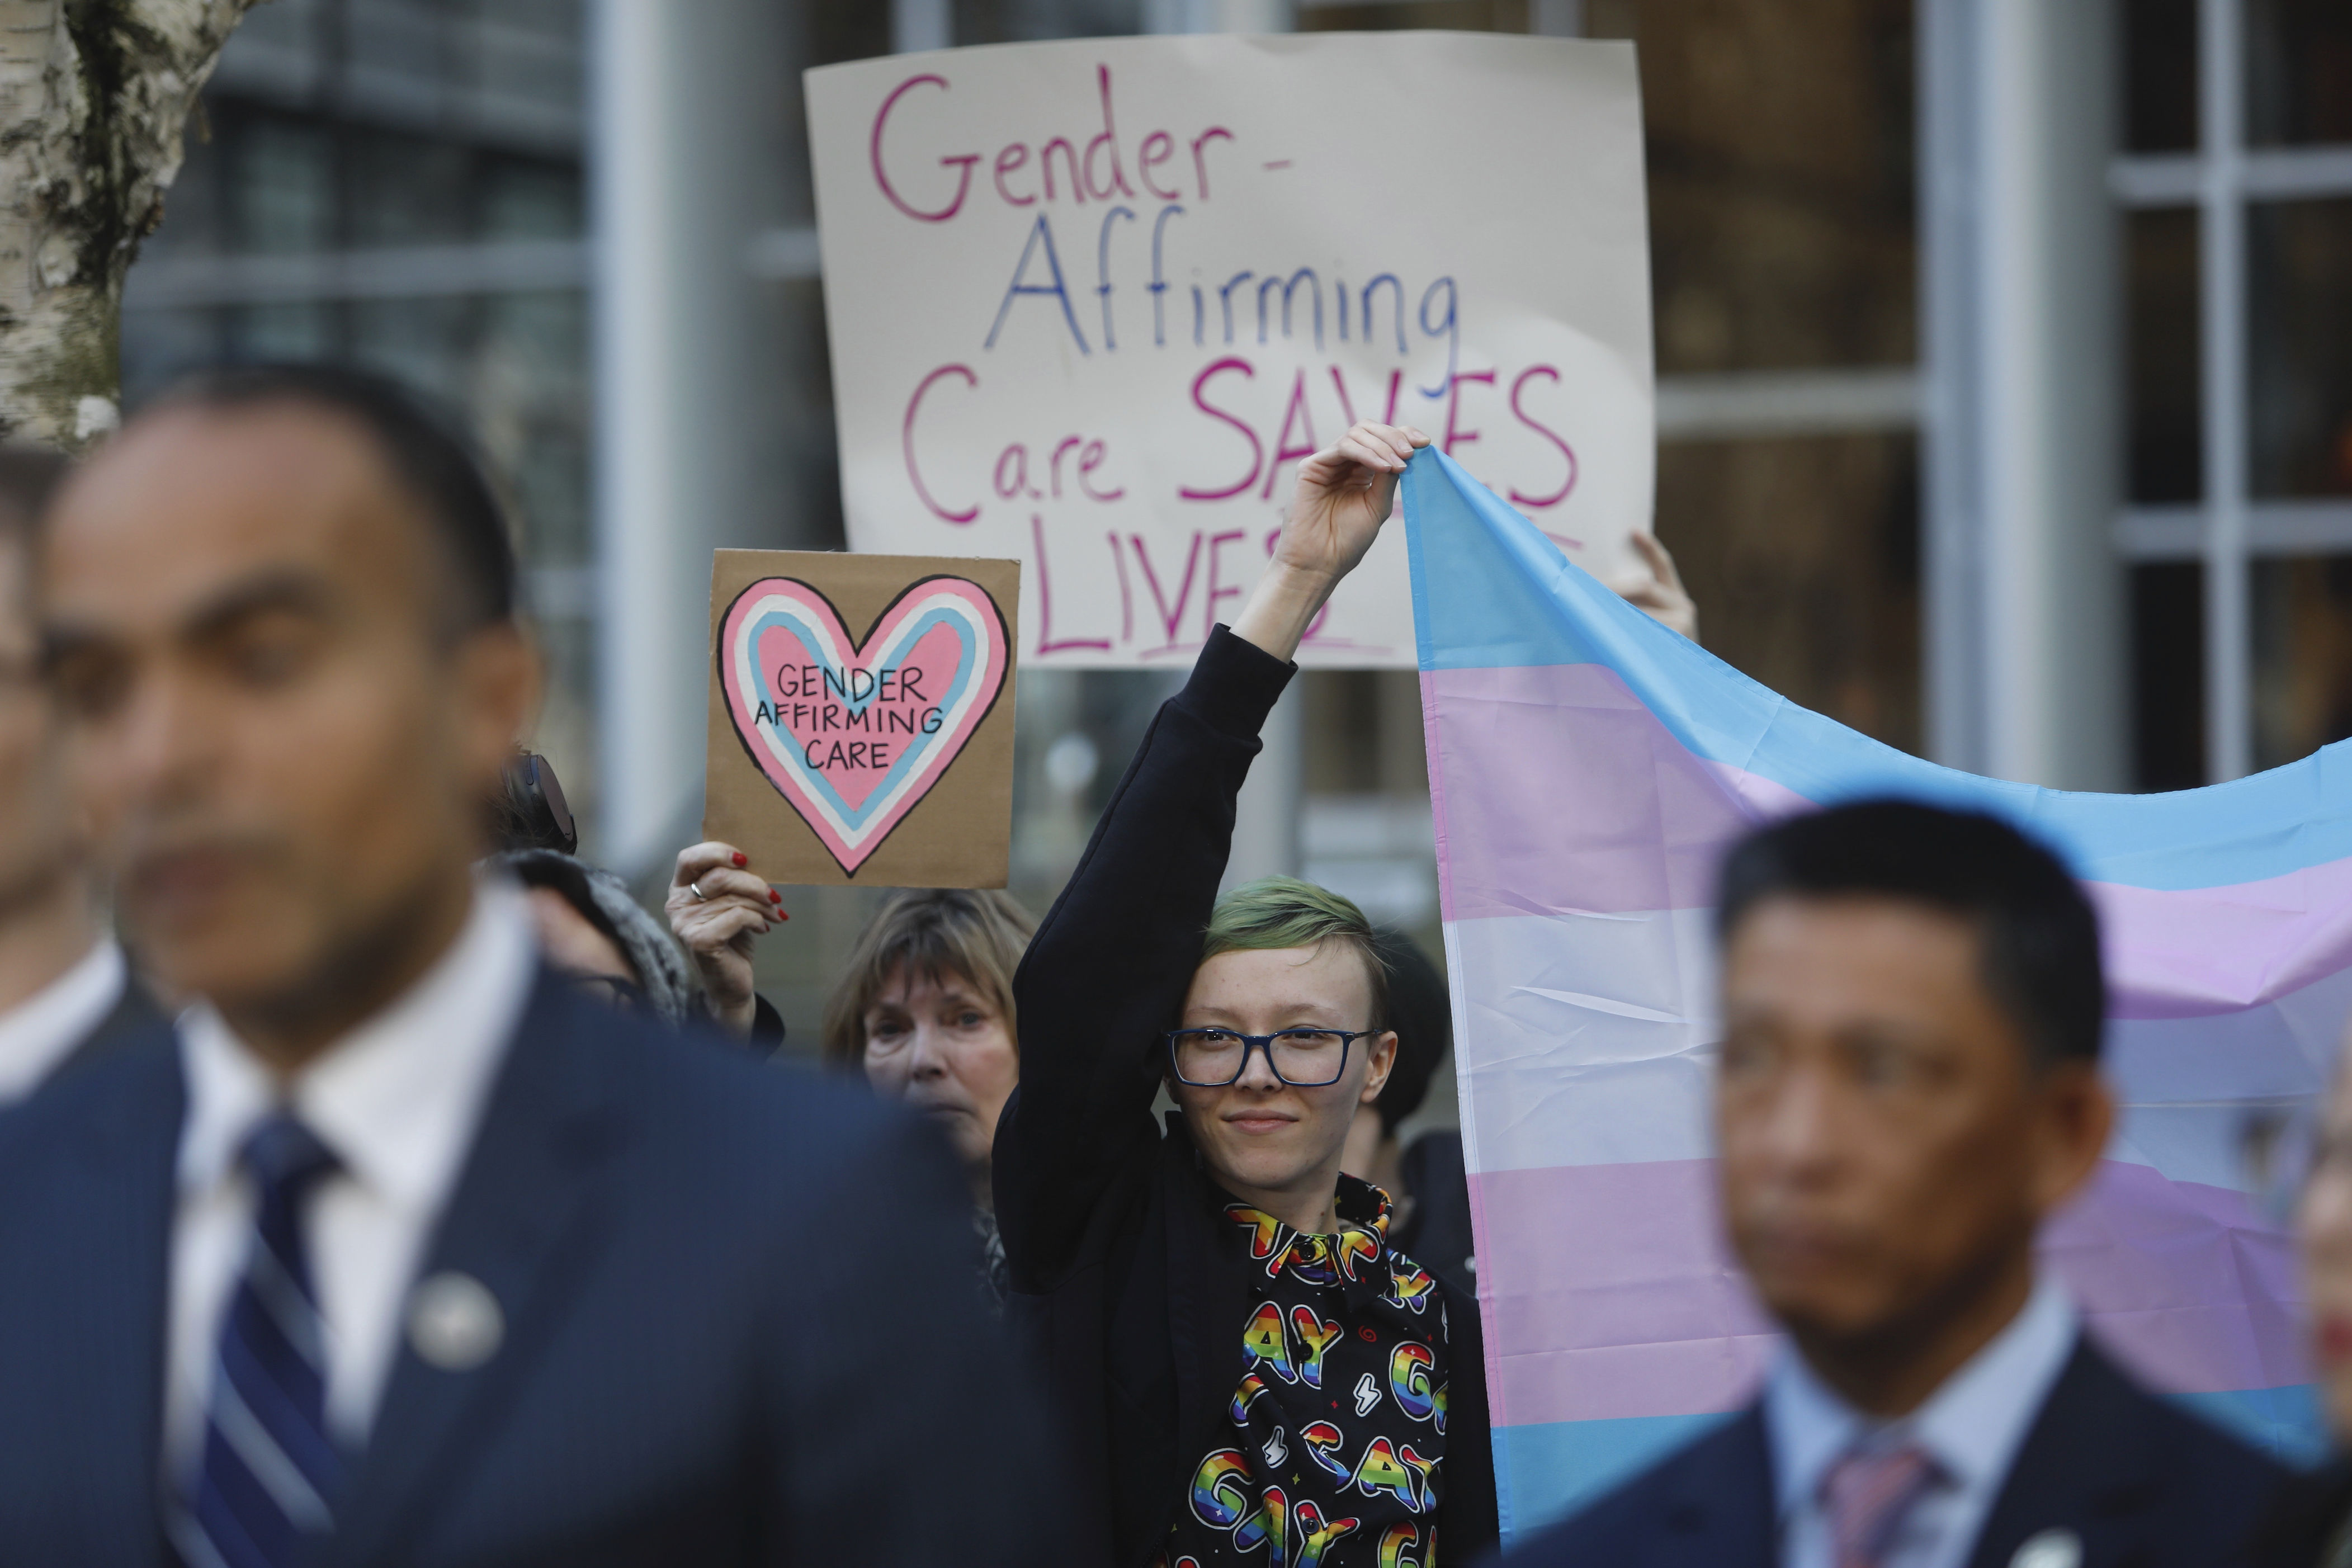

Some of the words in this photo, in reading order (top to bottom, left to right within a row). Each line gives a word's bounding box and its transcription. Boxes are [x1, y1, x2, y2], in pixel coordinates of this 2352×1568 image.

[984, 205, 1458, 399] Affirming
[903, 363, 1125, 524] Care
[777, 664, 927, 702] GENDER
[754, 701, 943, 734] AFFIRMING
[804, 739, 889, 770] CARE
